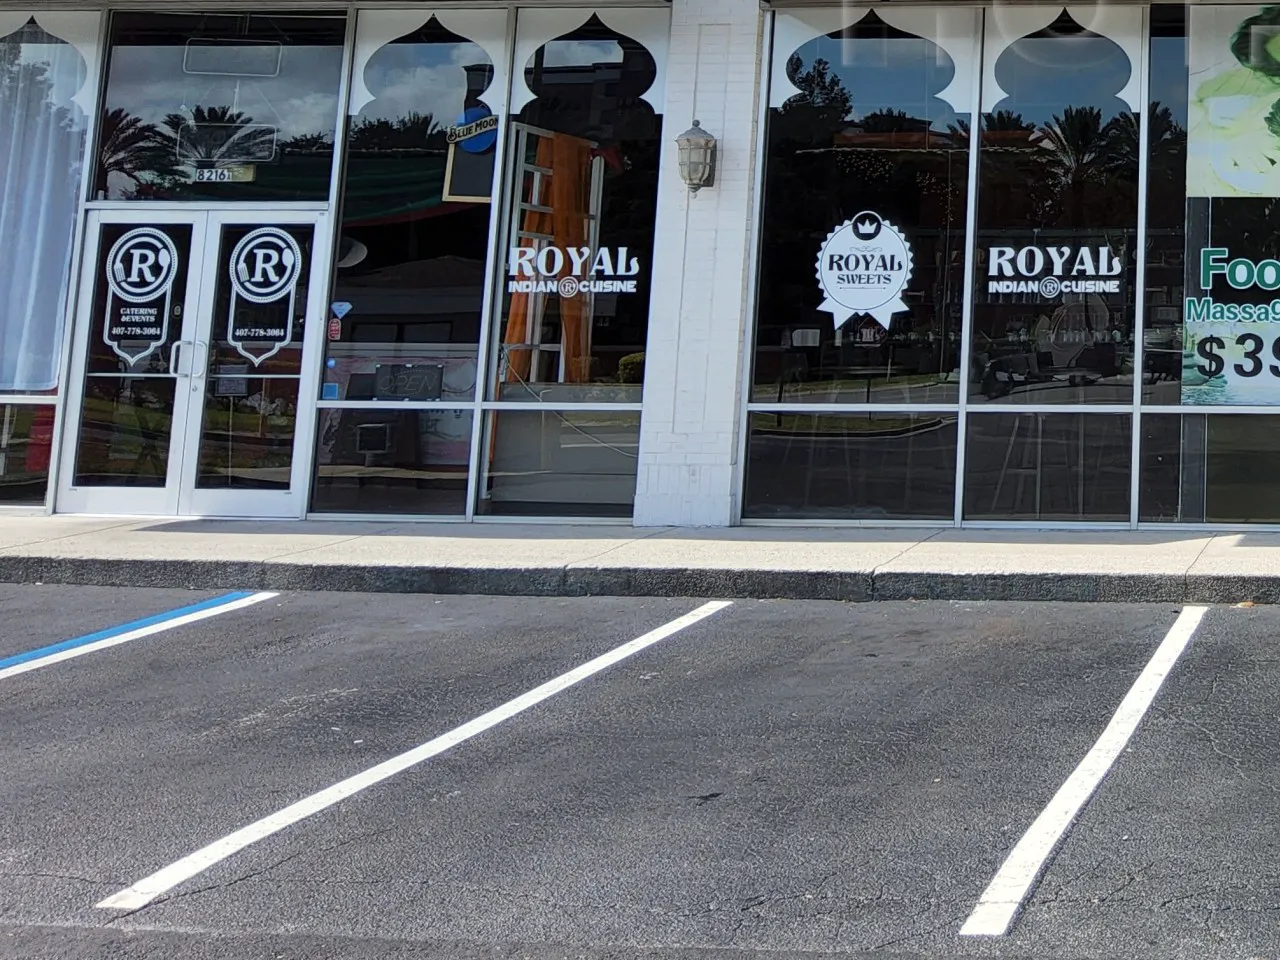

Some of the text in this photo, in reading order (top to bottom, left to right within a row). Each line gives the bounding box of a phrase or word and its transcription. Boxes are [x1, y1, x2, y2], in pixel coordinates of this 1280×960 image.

[446, 125, 474, 141] BLUE
[508, 246, 640, 276] ROYAL
[828, 253, 903, 271] ROYAL
[988, 245, 1122, 277] ROYAL
[836, 273, 892, 285] SWEETS
[508, 281, 557, 292] INDIAN
[579, 281, 637, 292] CUISINE
[988, 281, 1038, 293] INDIAN
[1060, 281, 1120, 293] CUISINE
[120, 307, 158, 315] CATERING
